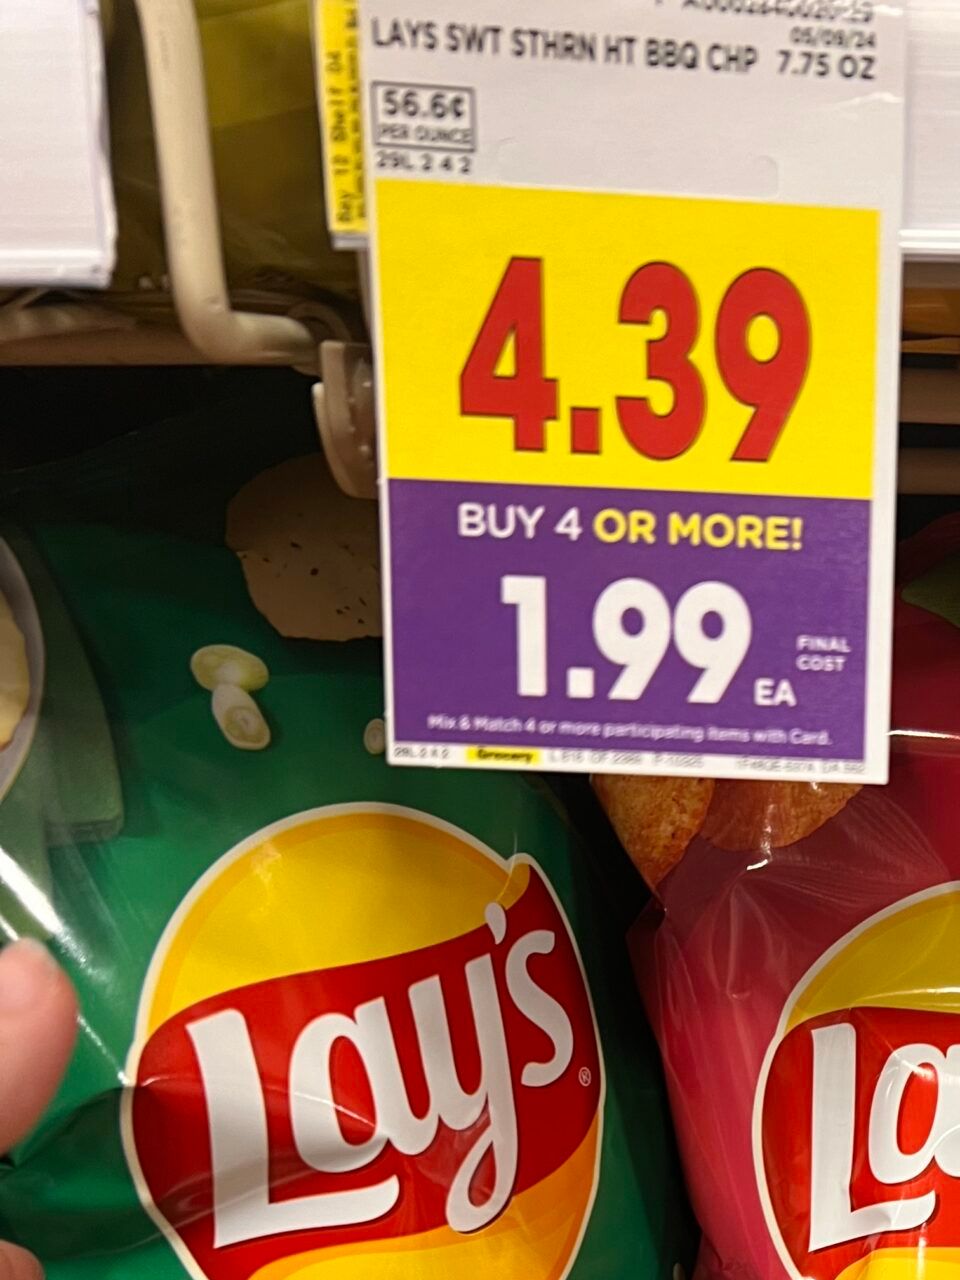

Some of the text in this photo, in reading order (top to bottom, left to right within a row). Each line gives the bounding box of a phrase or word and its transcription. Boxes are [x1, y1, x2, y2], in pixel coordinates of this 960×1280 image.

[371, 18, 876, 80] LAYS SWT STHRN HT BBQ CHP 7.75 OZ
[383, 88, 465, 118] 56.6¢
[440, 155, 453, 172] 4
[460, 156, 472, 175] 2
[459, 256, 813, 464] 4.39
[457, 502, 804, 552] BUY 4 OR MORE!
[501, 575, 798, 708] 1.99 EA
[797, 635, 852, 654] FINAL
[797, 654, 846, 673] COST
[427, 713, 833, 746] Mix & Match 4 or more participating items with Card.
[185, 900, 575, 1250] Lay's
